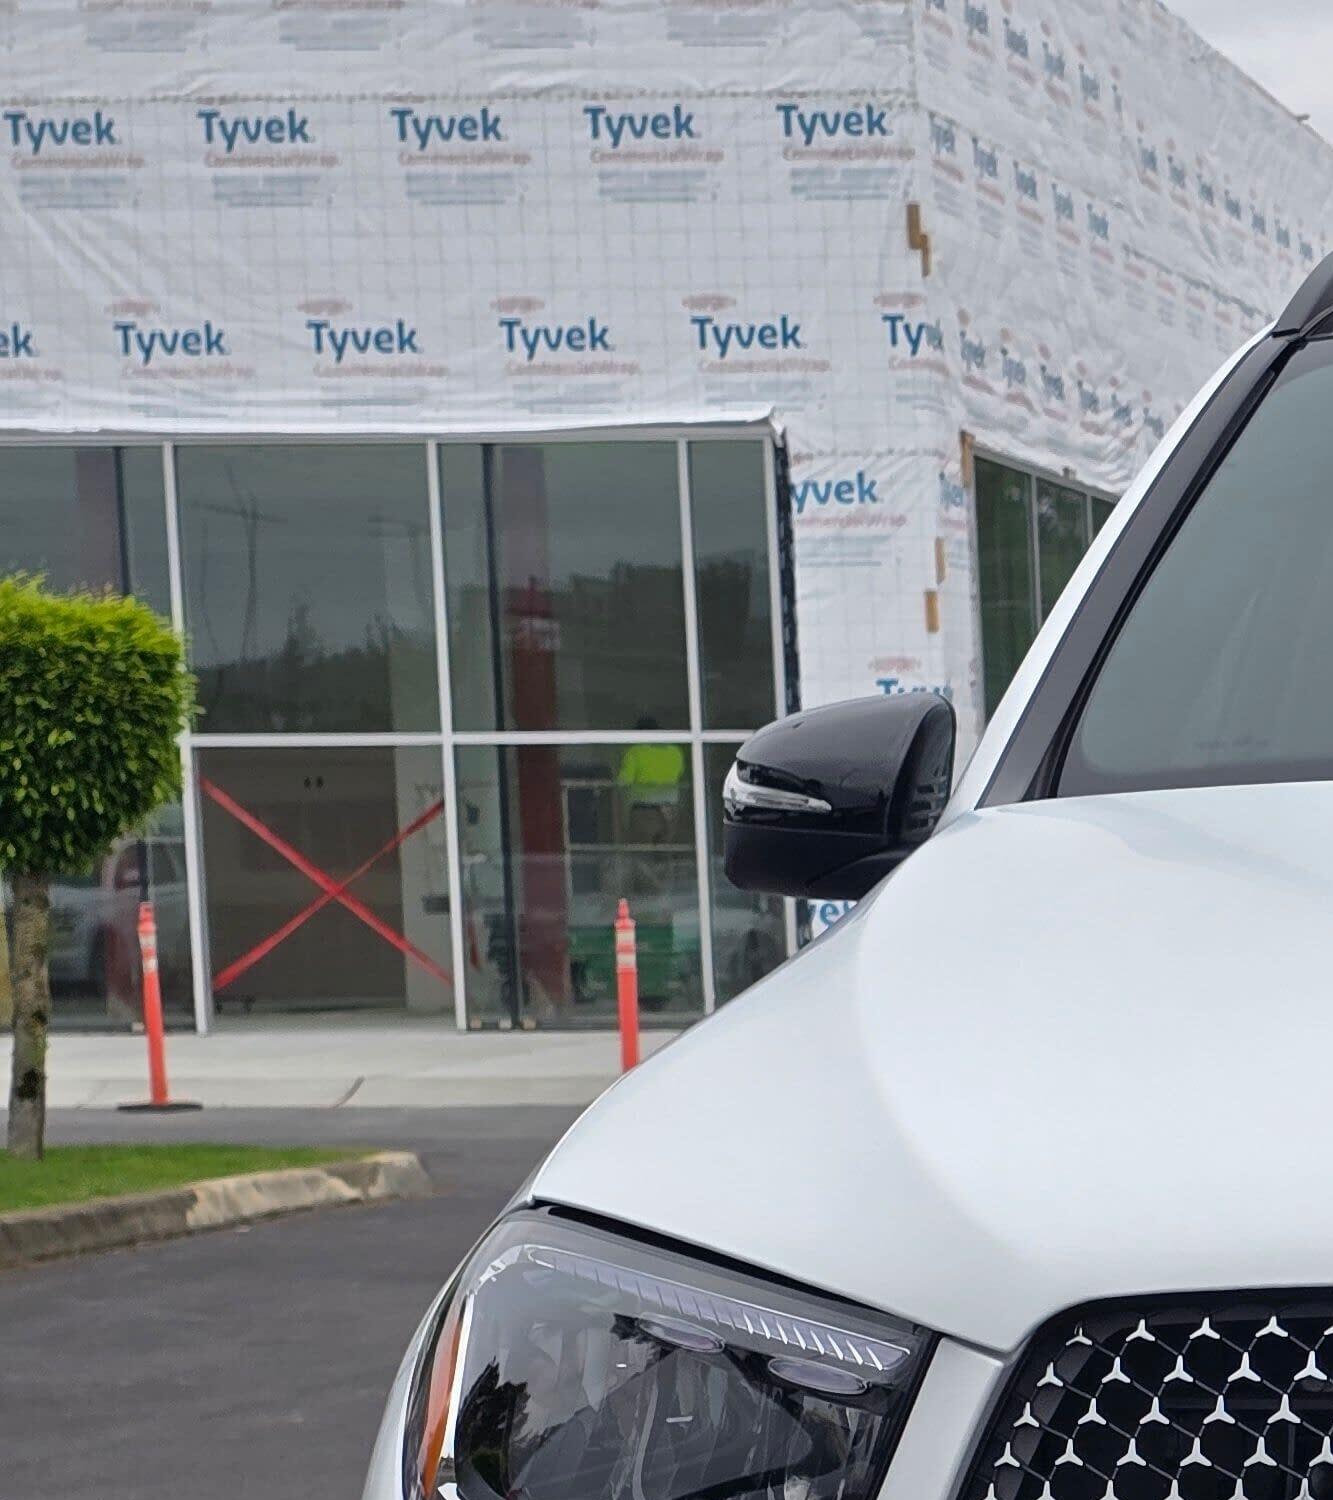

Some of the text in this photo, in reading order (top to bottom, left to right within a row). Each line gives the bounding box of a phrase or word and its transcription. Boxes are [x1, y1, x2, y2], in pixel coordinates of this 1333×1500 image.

[4, 112, 115, 155] Tyvek
[197, 109, 309, 153] Tyvek
[390, 108, 501, 150] Tyvek
[583, 104, 694, 148] Tyvek
[776, 104, 887, 146] Tyvek
[114, 321, 224, 364] Tyvek
[307, 320, 417, 363] Tyvek
[499, 318, 609, 360] Tyvek
[691, 315, 800, 358] Tyvek
